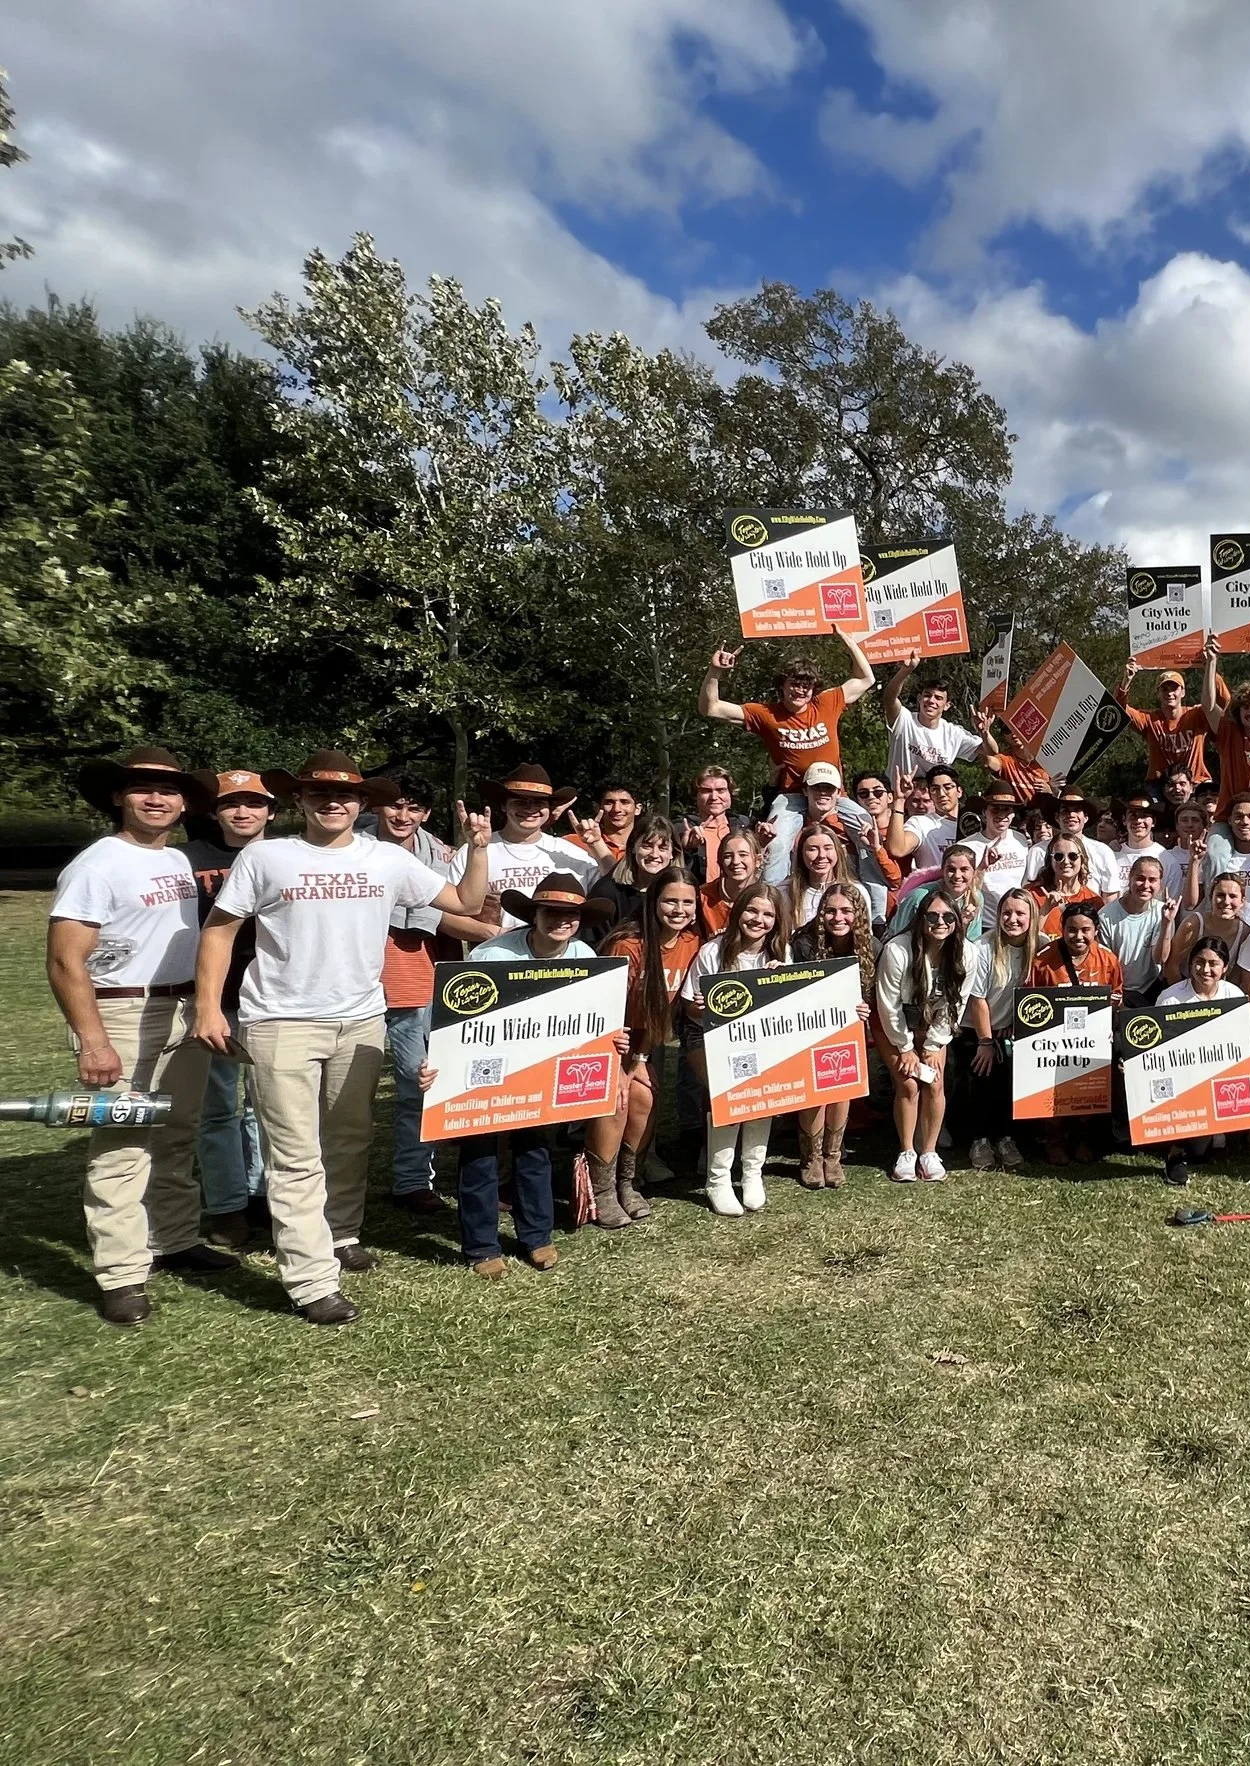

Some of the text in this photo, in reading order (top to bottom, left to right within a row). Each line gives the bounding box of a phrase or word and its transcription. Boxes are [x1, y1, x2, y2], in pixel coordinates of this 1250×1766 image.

[749, 550, 847, 572] City Wide Hold Up
[883, 583, 909, 601] Wide
[910, 580, 933, 598] Hold
[935, 579, 949, 597] Up
[1225, 581, 1250, 594] City
[1141, 606, 1191, 621] City Wide
[1146, 621, 1188, 632] Hold Up
[1079, 694, 1099, 714] City
[1067, 709, 1086, 729] Wide
[778, 722, 828, 742] TEXAS
[1050, 726, 1071, 749] Hold
[779, 735, 830, 750] ENGINEERING
[1041, 743, 1056, 757] Up
[1001, 852, 1018, 860] EXAS
[299, 872, 368, 886] TEXAS
[502, 866, 550, 878] TEXAS
[150, 873, 193, 889] TEXAS
[140, 885, 198, 907] WRANGLE
[280, 885, 385, 901] WRANGLERS
[454, 982, 480, 998] Texas
[461, 1012, 605, 1047] City Wide Hold Up
[728, 1007, 847, 1043] City Wide Hold Up
[1032, 1037, 1096, 1052] City Wide
[1037, 1055, 1090, 1068] Hold Up
[1142, 1042, 1242, 1072] City Wide Hold Up
[559, 1083, 584, 1091] Easter
[585, 1080, 606, 1088] Seals
[763, 1083, 791, 1095] Children
[792, 1079, 805, 1089] and
[69, 1096, 90, 1123] YETI
[444, 1091, 543, 1114] Benefiting Children and
[752, 1102, 767, 1112] with
[443, 1116, 470, 1131] Adults
[472, 1113, 491, 1128] with
